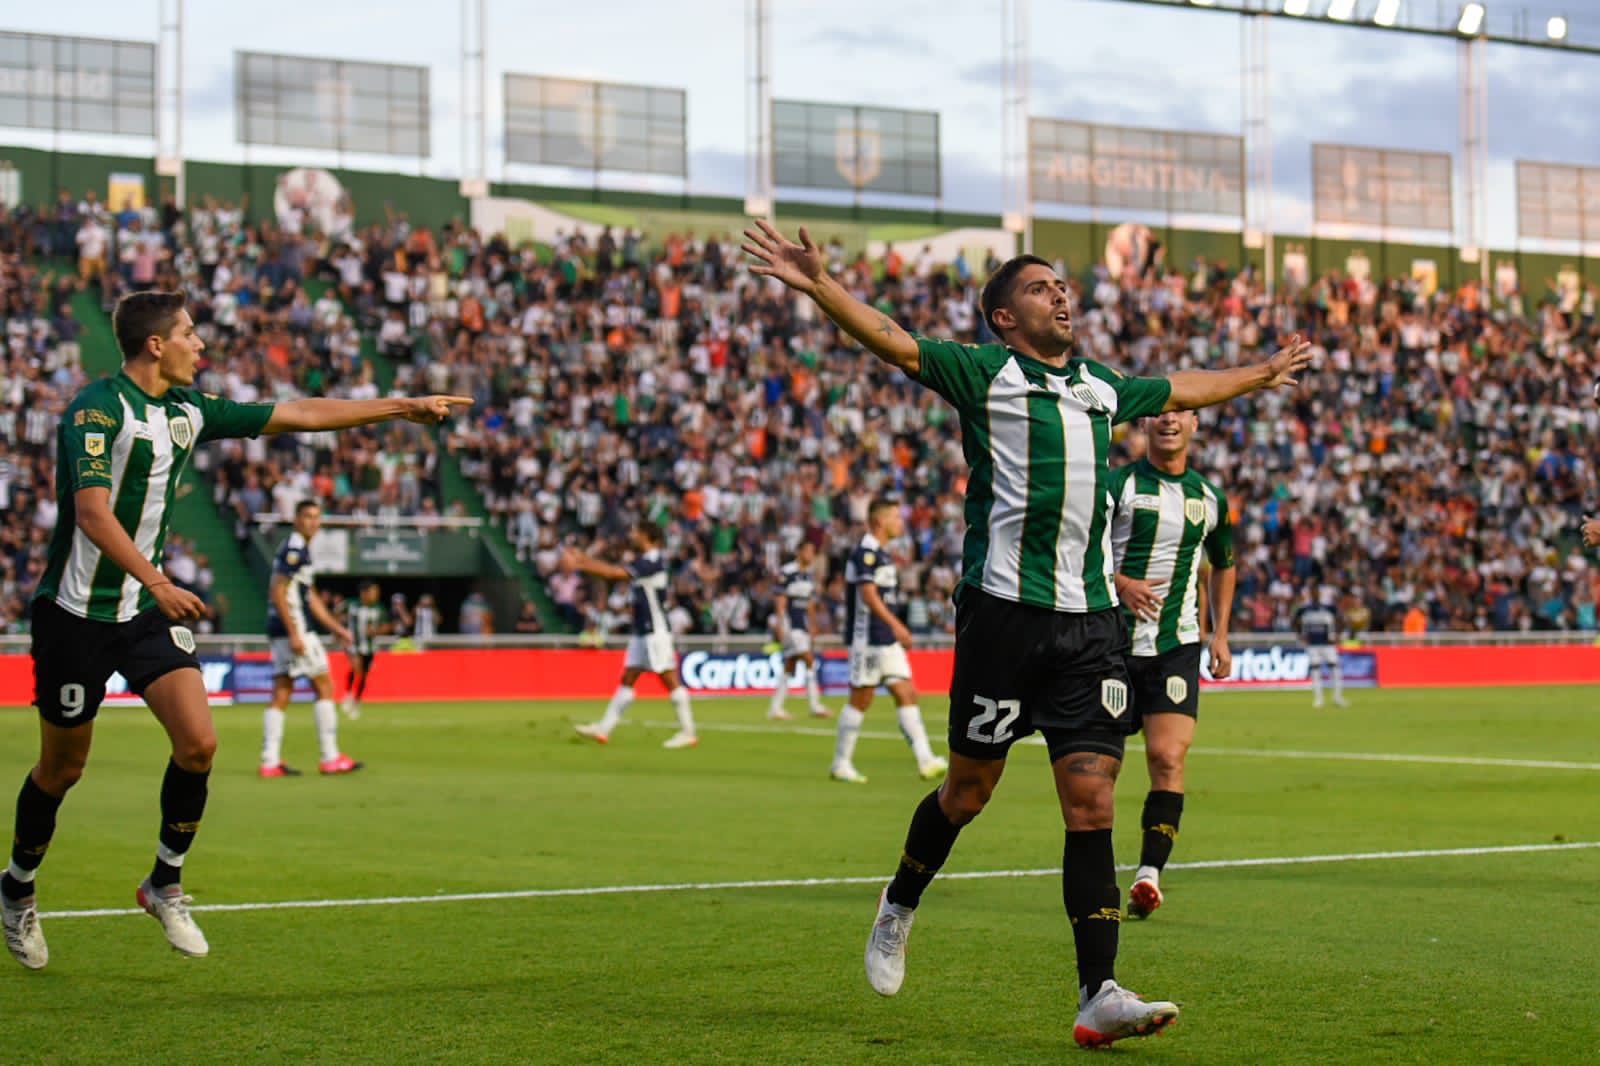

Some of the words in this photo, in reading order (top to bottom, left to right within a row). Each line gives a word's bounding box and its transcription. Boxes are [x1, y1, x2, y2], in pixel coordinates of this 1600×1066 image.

[1047, 154, 1230, 193] ARGENTINA
[681, 651, 820, 689] CartaSu
[1200, 646, 1311, 682] CrtaSur
[60, 683, 85, 718] 9
[966, 694, 1021, 744] 22
